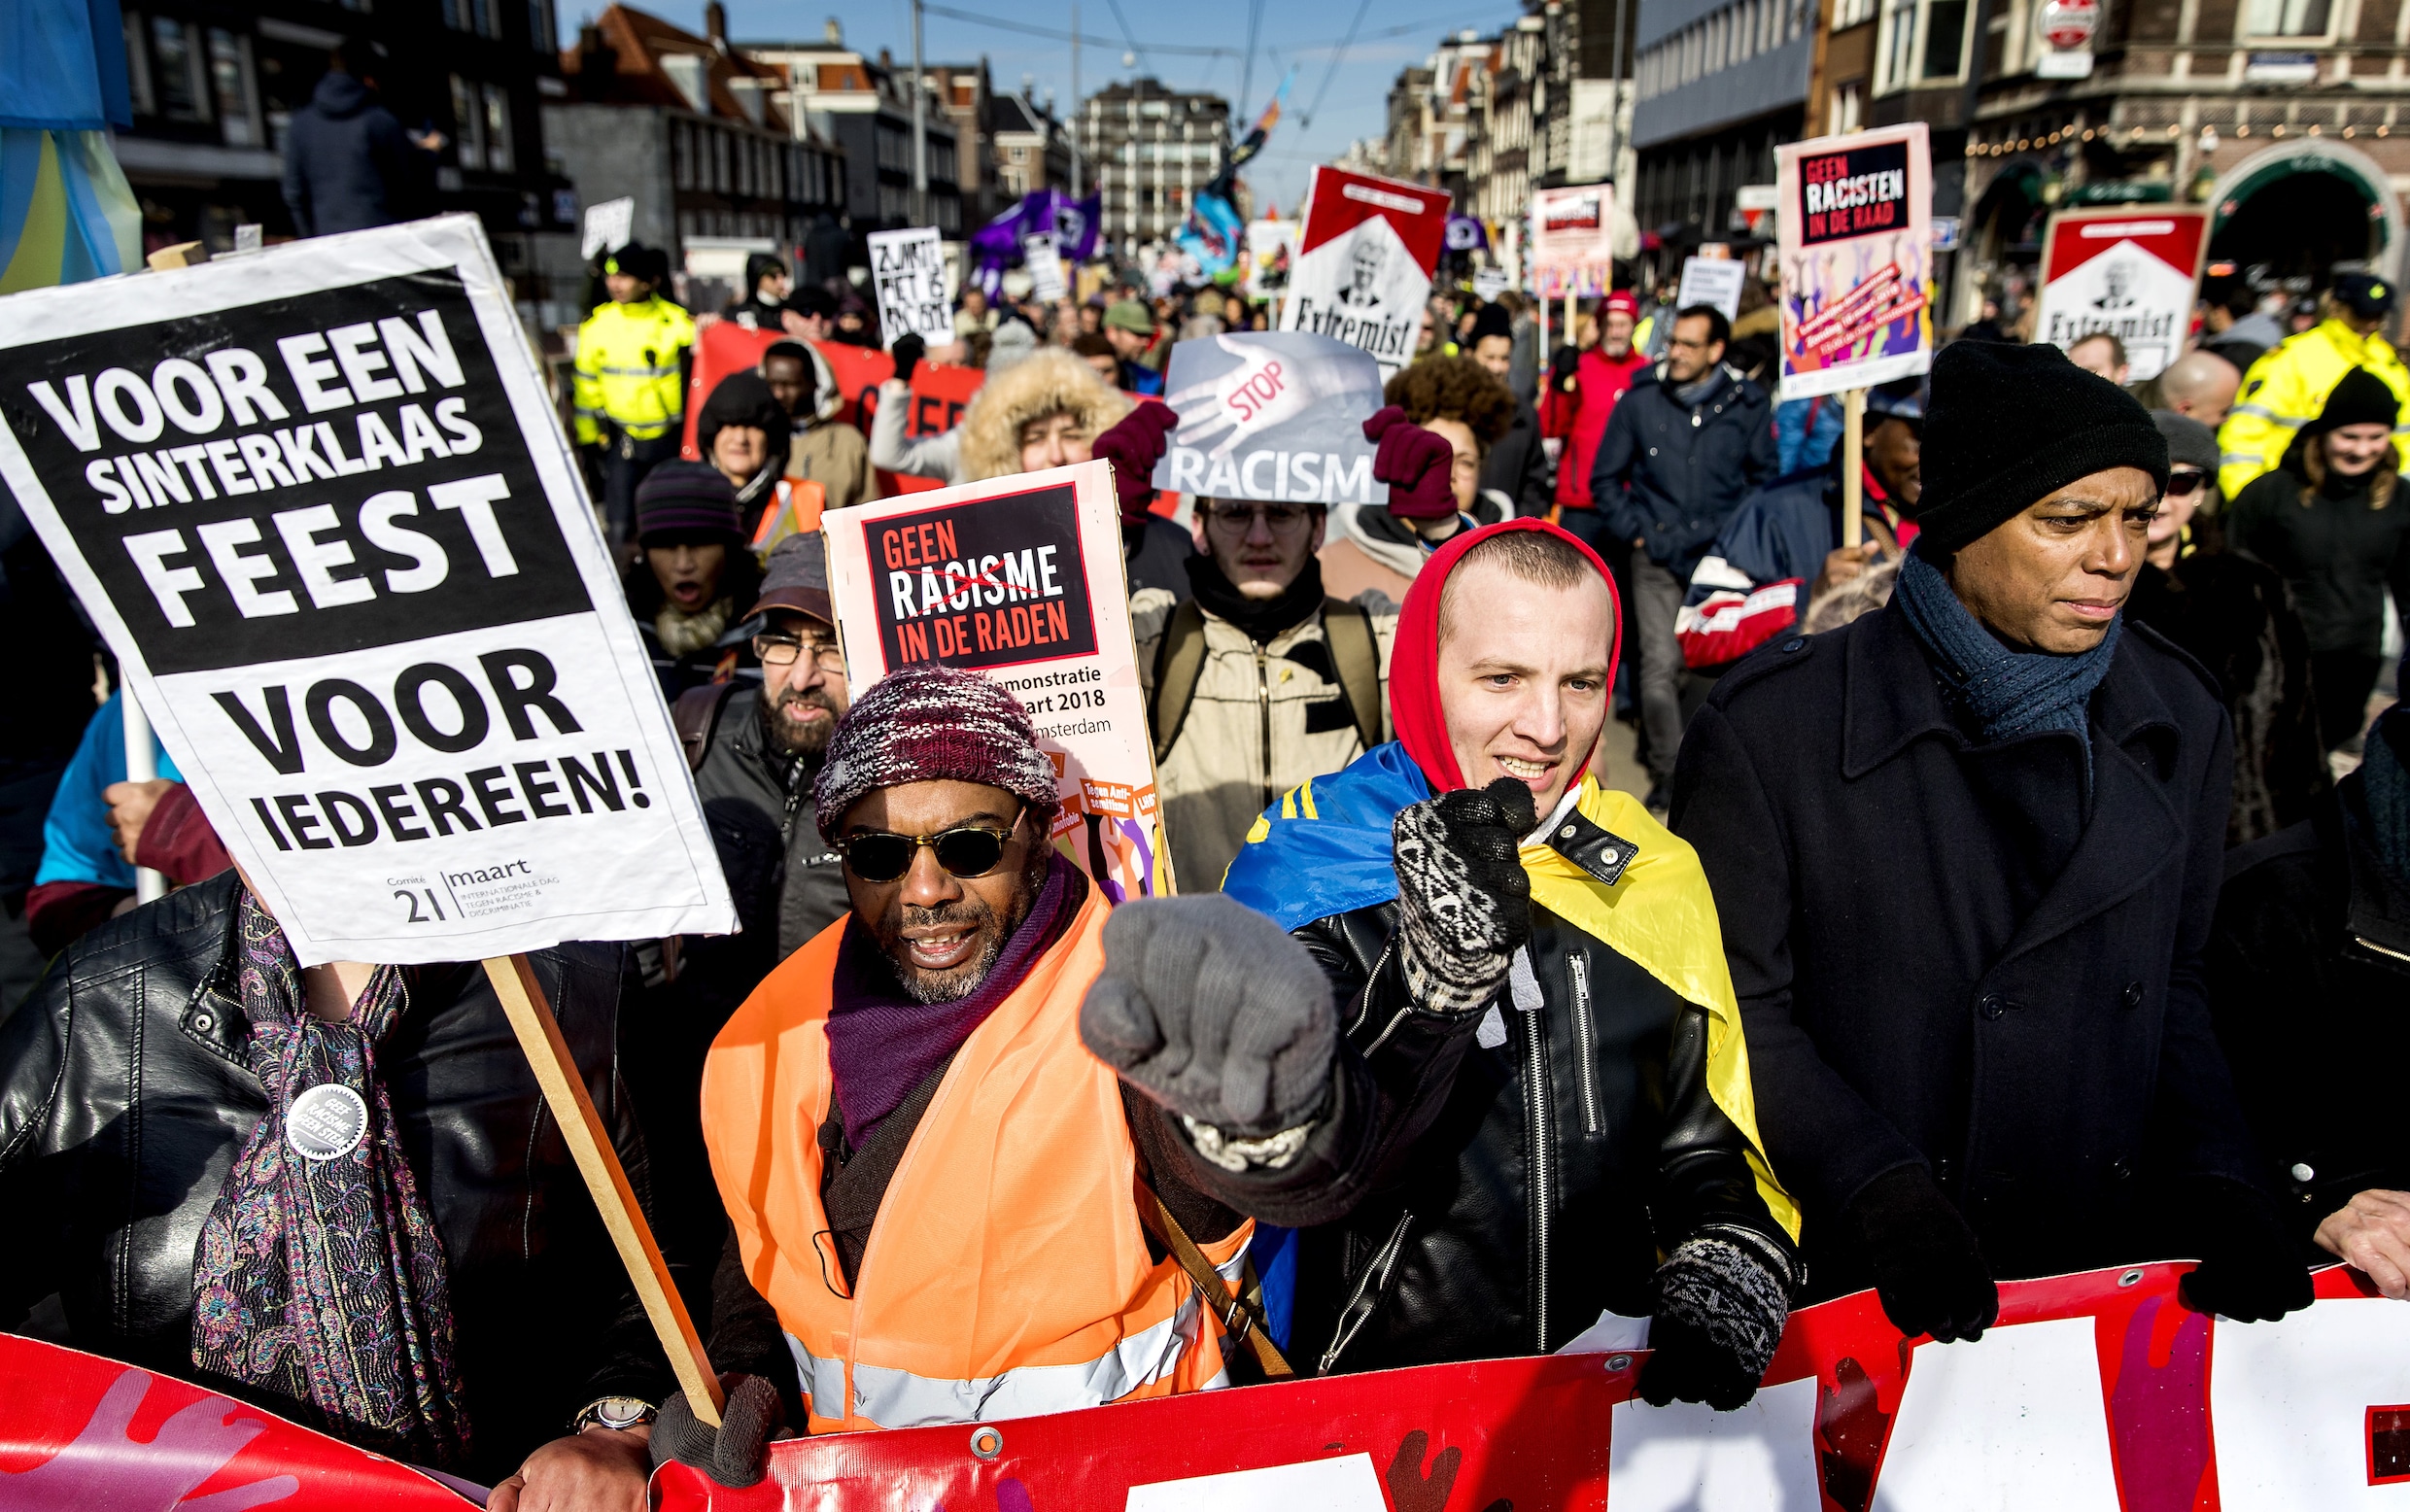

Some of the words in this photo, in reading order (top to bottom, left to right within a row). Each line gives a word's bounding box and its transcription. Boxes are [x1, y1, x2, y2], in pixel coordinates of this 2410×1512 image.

[1807, 155, 1848, 184] GEEN
[1807, 168, 1904, 214] RACISTEN
[1809, 213, 1826, 237] IN
[1830, 208, 1850, 234] DE
[1853, 201, 1894, 230] RAAD
[26, 348, 291, 453] VOOR
[277, 309, 466, 414] EEN
[1227, 360, 1284, 422] STOP
[86, 396, 483, 514] SINTERKLAAS
[1169, 446, 1371, 502] RACISM
[122, 473, 519, 628] FEEST
[882, 519, 958, 570] GEEN
[889, 544, 1063, 620] RACISME
[896, 620, 929, 664] IN
[934, 613, 973, 660] DE
[977, 600, 1070, 653] RADEN
[209, 647, 585, 775] VOOR
[1025, 696, 1053, 714] art
[1057, 689, 1106, 711] 2018
[1035, 718, 1111, 739] msterdam
[249, 749, 651, 851] IEDEREEN!
[1084, 783, 1109, 798] Tegen
[1110, 785, 1131, 801] Anti-
[1090, 799, 1129, 813] semitisme
[387, 876, 427, 886] Comité
[394, 888, 446, 923] 21
[448, 859, 532, 887] maart
[461, 879, 536, 900] INTERNATIONALE
[539, 876, 560, 887] DAG
[465, 896, 495, 910] TEGEN
[496, 891, 534, 905] RACISME
[469, 900, 533, 917] DISCRIMINATIE
[307, 1103, 352, 1133] RACISME
[325, 1098, 352, 1116] GEEF
[294, 1113, 325, 1133] GEEN
[319, 1127, 349, 1149] STEM
